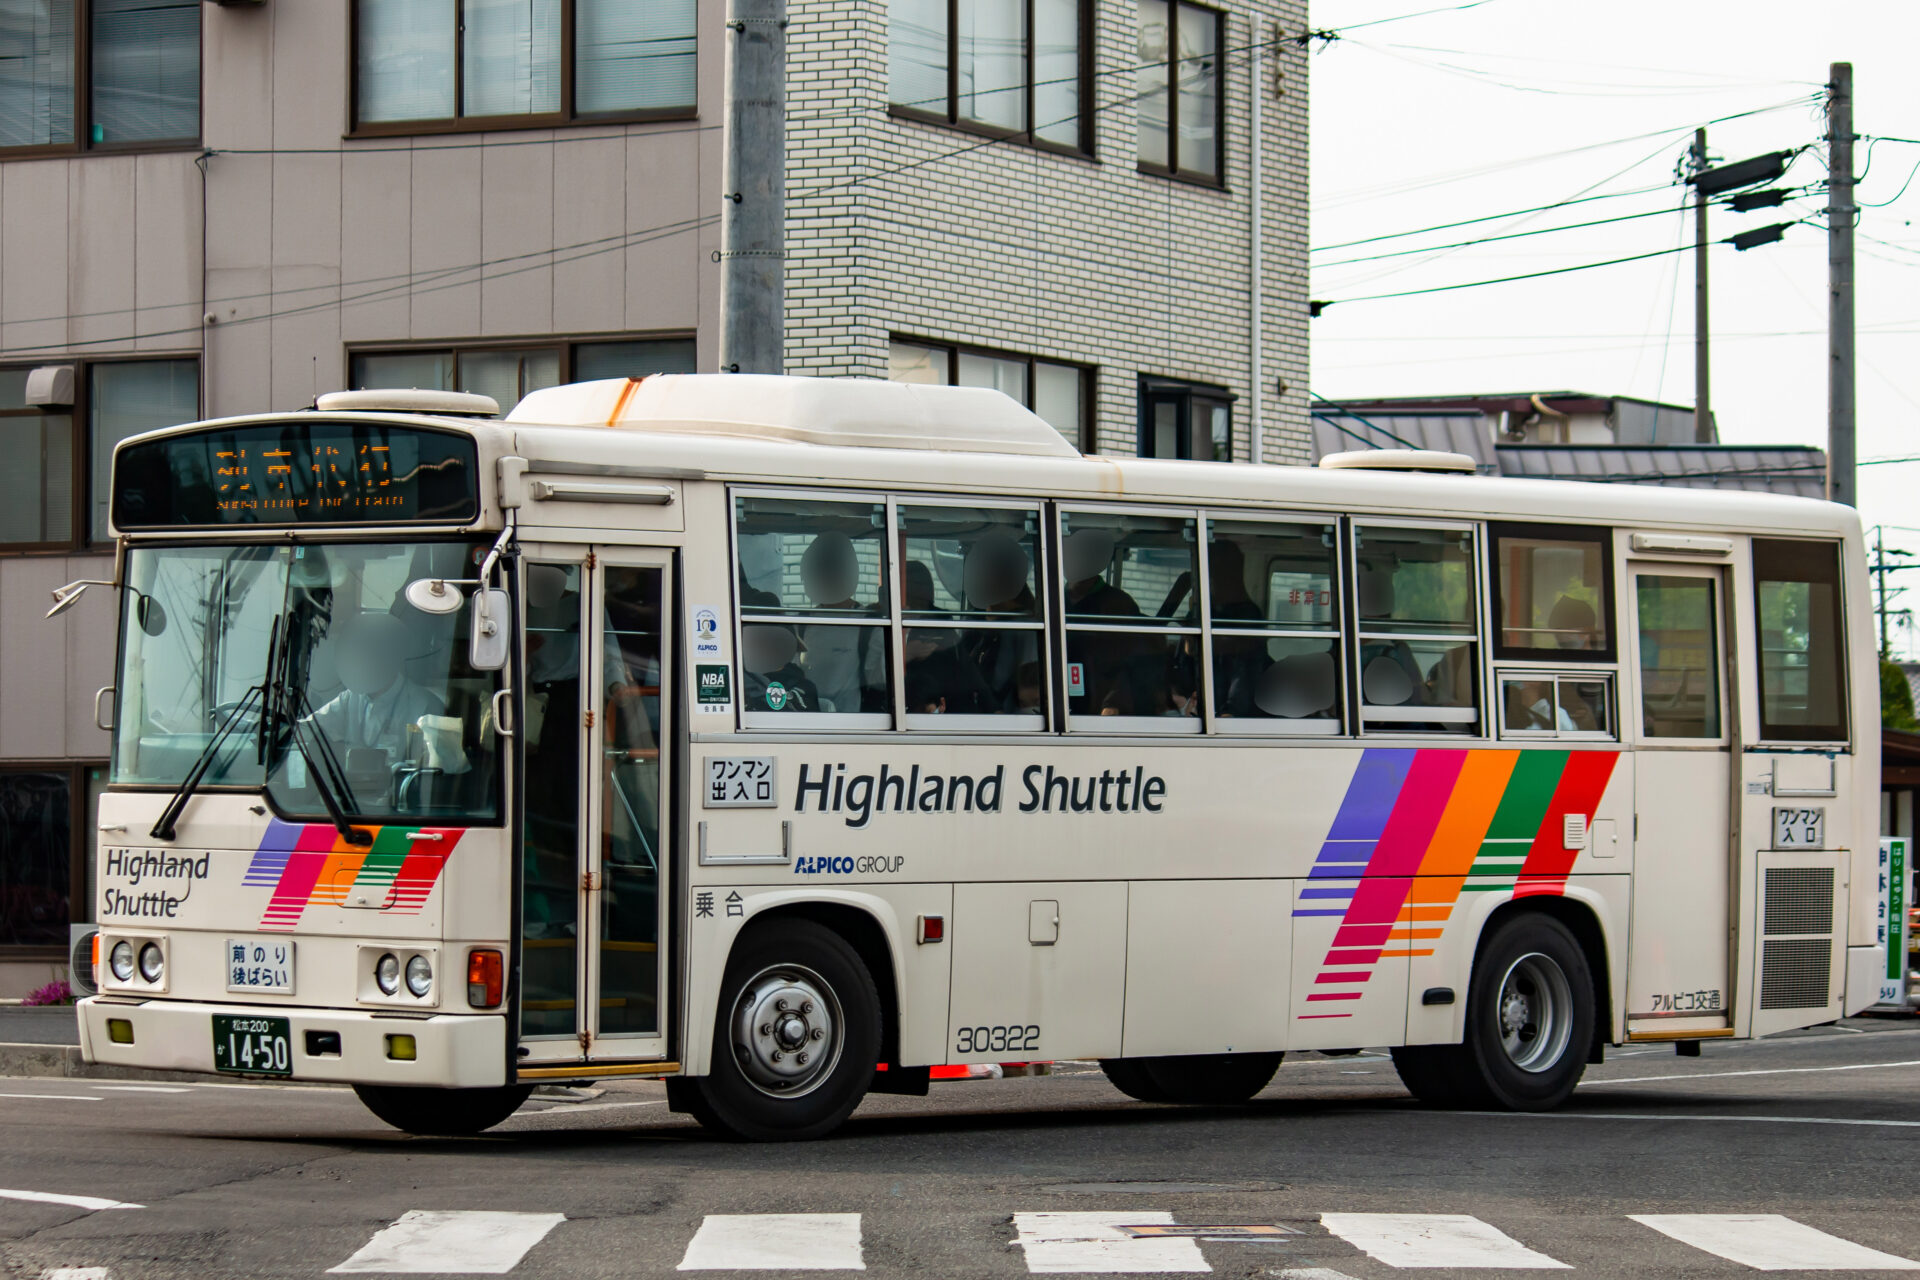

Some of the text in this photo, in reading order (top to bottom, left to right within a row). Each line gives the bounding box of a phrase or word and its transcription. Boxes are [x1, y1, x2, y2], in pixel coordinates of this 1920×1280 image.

[702, 673, 725, 685] NBA
[712, 760, 771, 780] ワンマン
[712, 782, 771, 801] 出入口
[795, 763, 1166, 828] Highland Shuttle
[1780, 809, 1821, 826] ワンマン
[1784, 827, 1816, 842] 入口
[106, 849, 209, 886] Highland
[794, 857, 904, 875] ALPICO GROUP
[103, 888, 178, 917] Shuttle
[696, 891, 744, 918] 乗合
[232, 945, 287, 964] 前のり
[232, 967, 287, 986] 後ばらい
[1651, 990, 1720, 1012] アルピコ交通
[957, 1026, 1040, 1053] 30322
